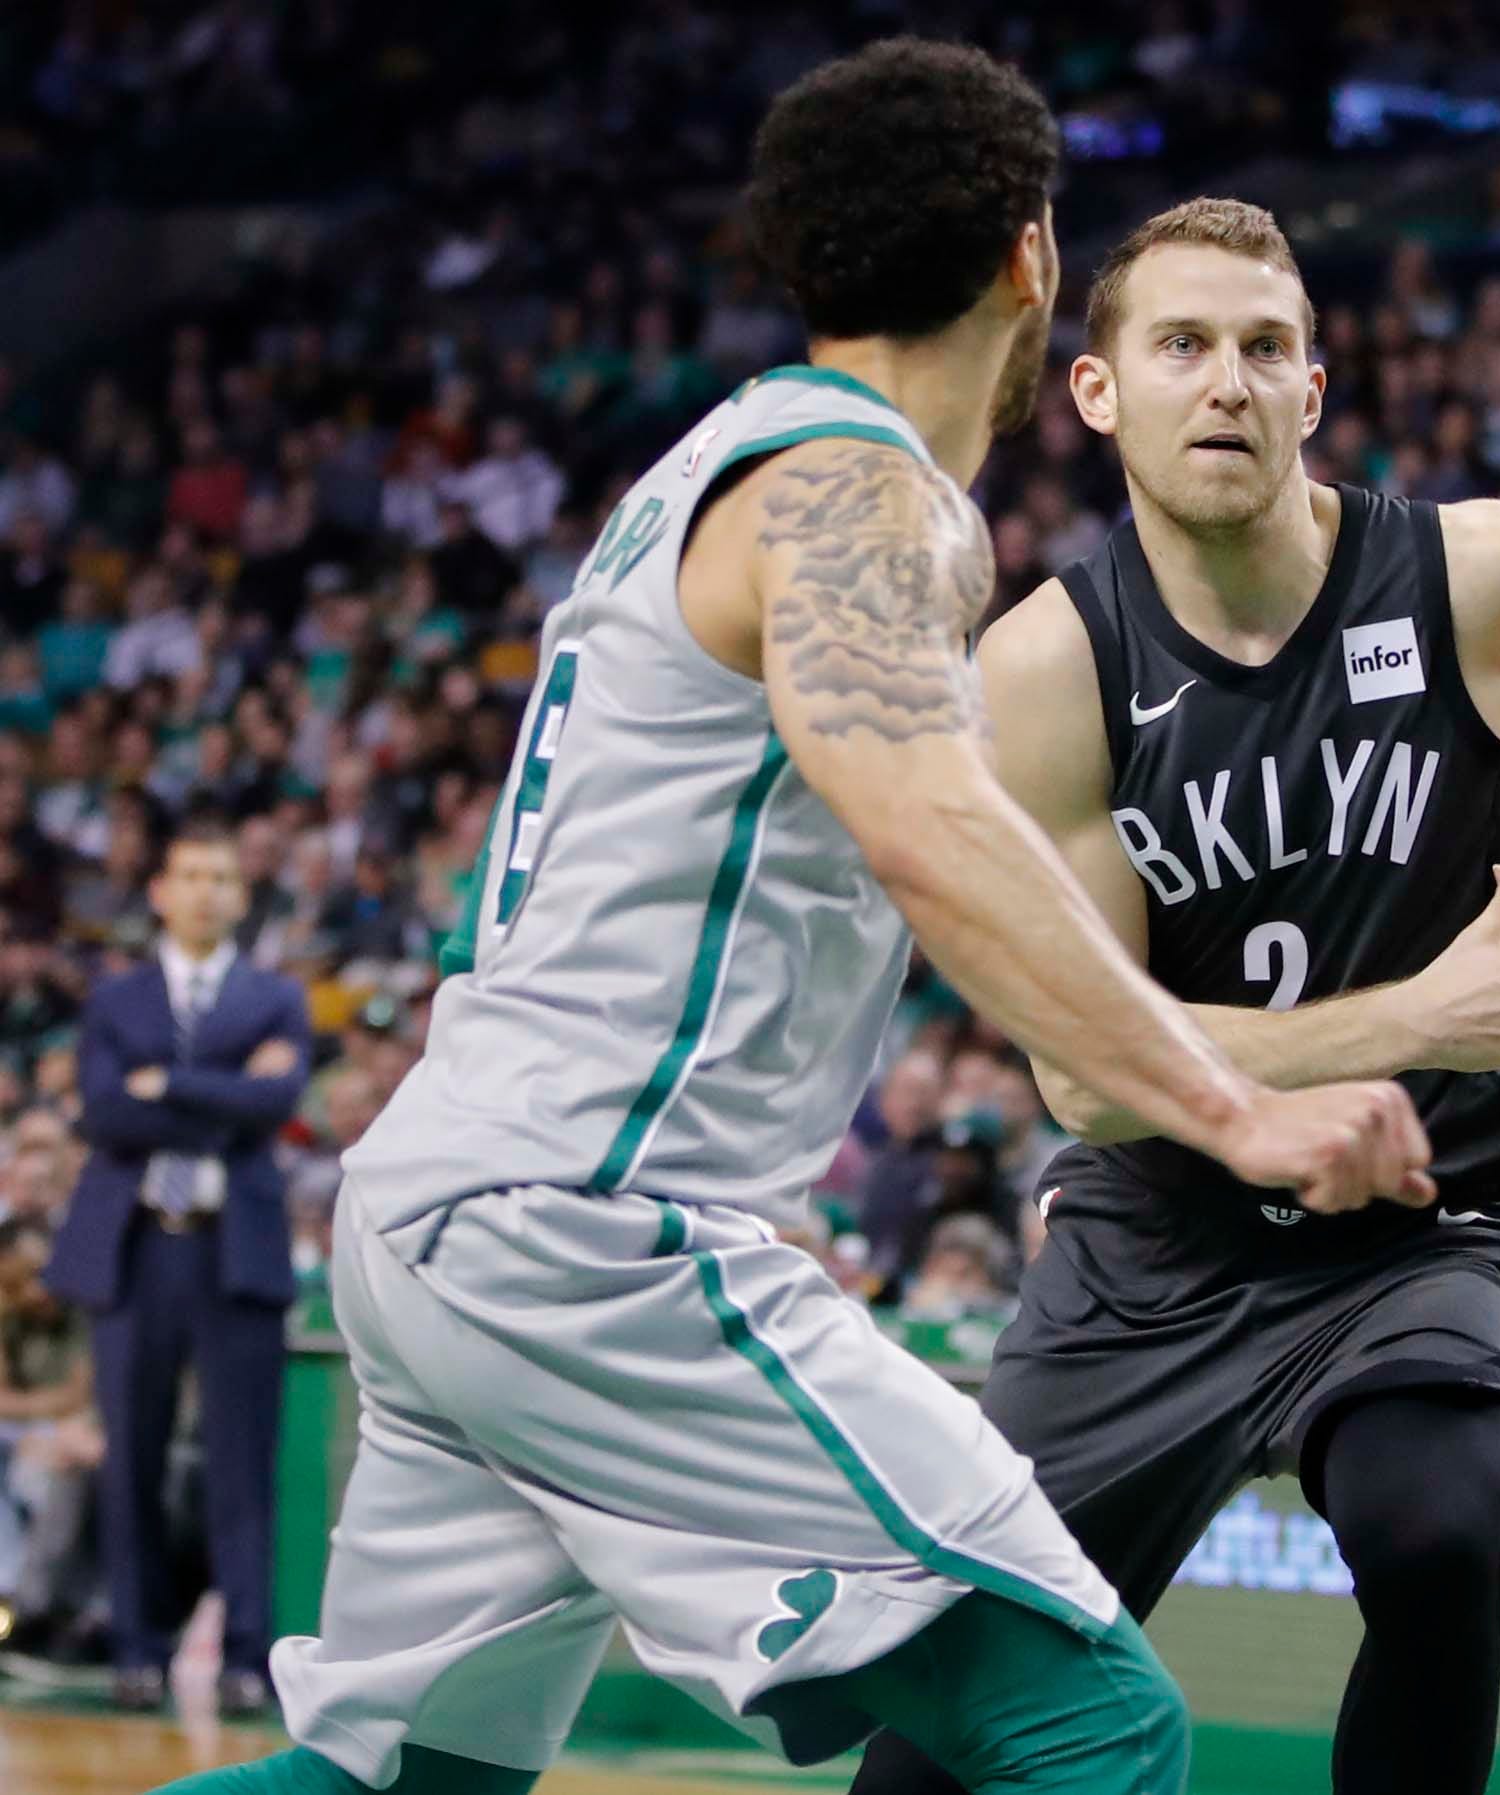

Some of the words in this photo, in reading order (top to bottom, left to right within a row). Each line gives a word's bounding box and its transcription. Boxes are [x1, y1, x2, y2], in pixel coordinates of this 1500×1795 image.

[1351, 645, 1412, 675] infor
[1110, 738, 1440, 905] BKLYN
[1243, 921, 1309, 1013] 2
